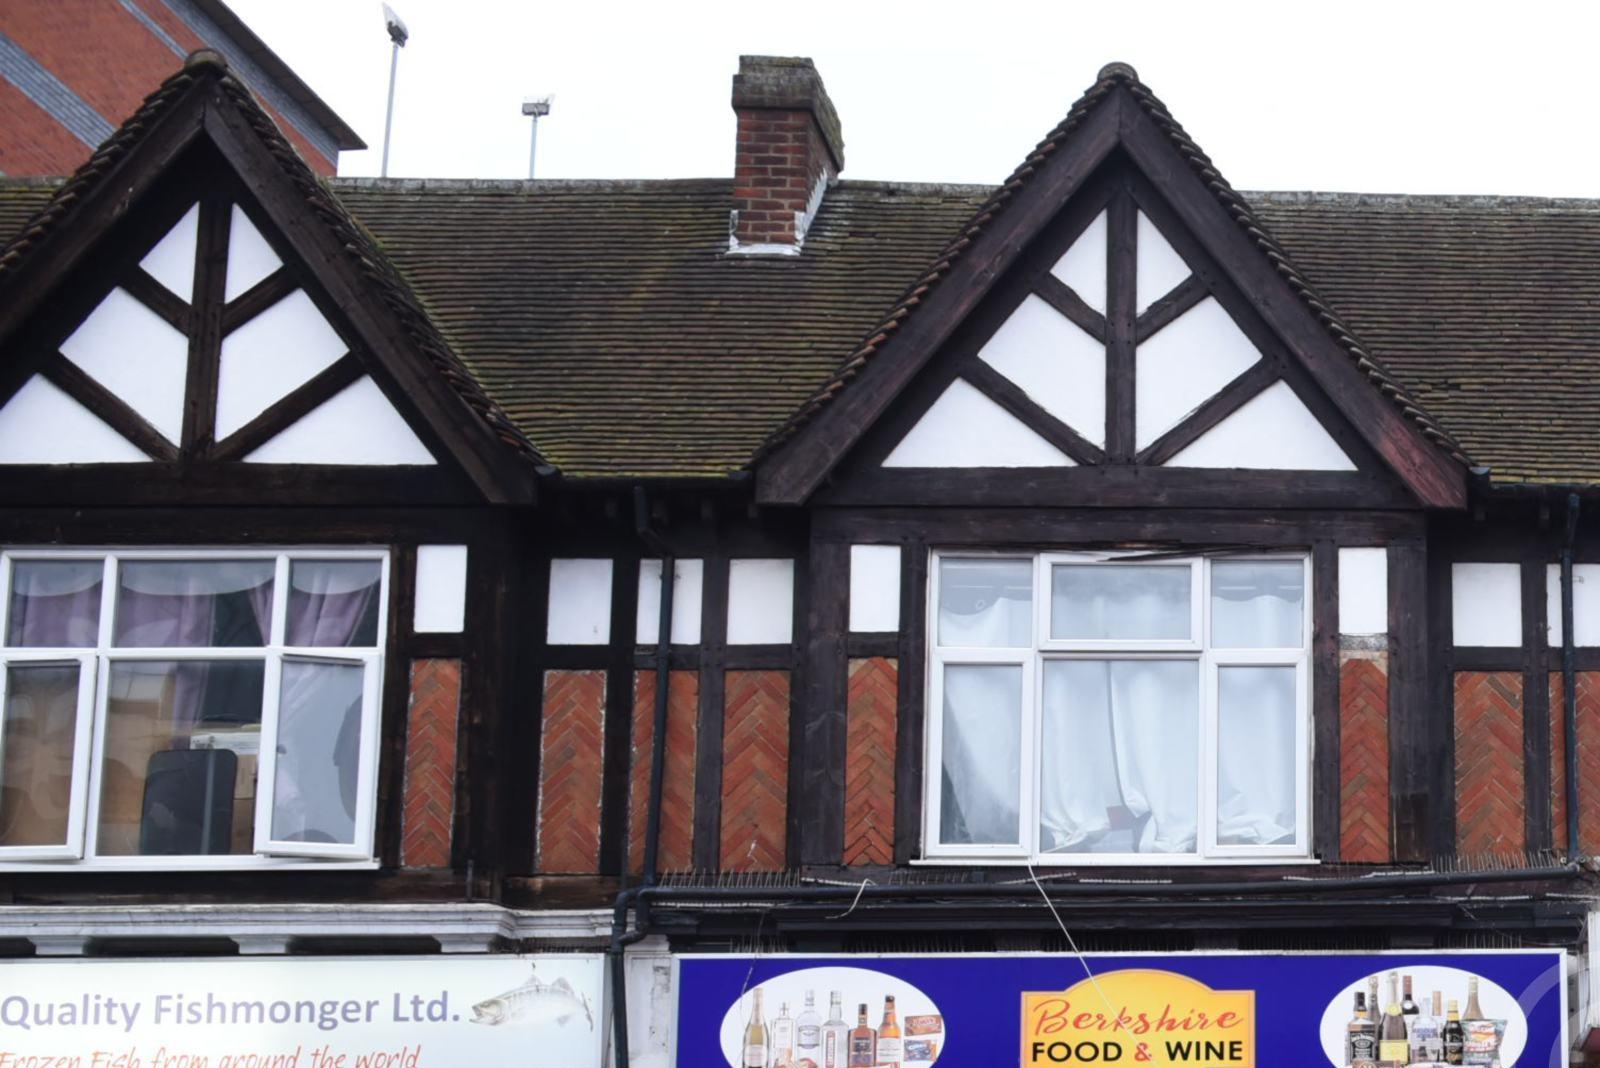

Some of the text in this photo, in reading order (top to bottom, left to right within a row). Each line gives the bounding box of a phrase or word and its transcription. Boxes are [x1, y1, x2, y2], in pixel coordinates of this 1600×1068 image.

[1, 991, 460, 1032] Quality Fishmonger Ltd.
[1033, 999, 1243, 1035] Berkshire
[1032, 1041, 1243, 1062] FOOD & WINE
